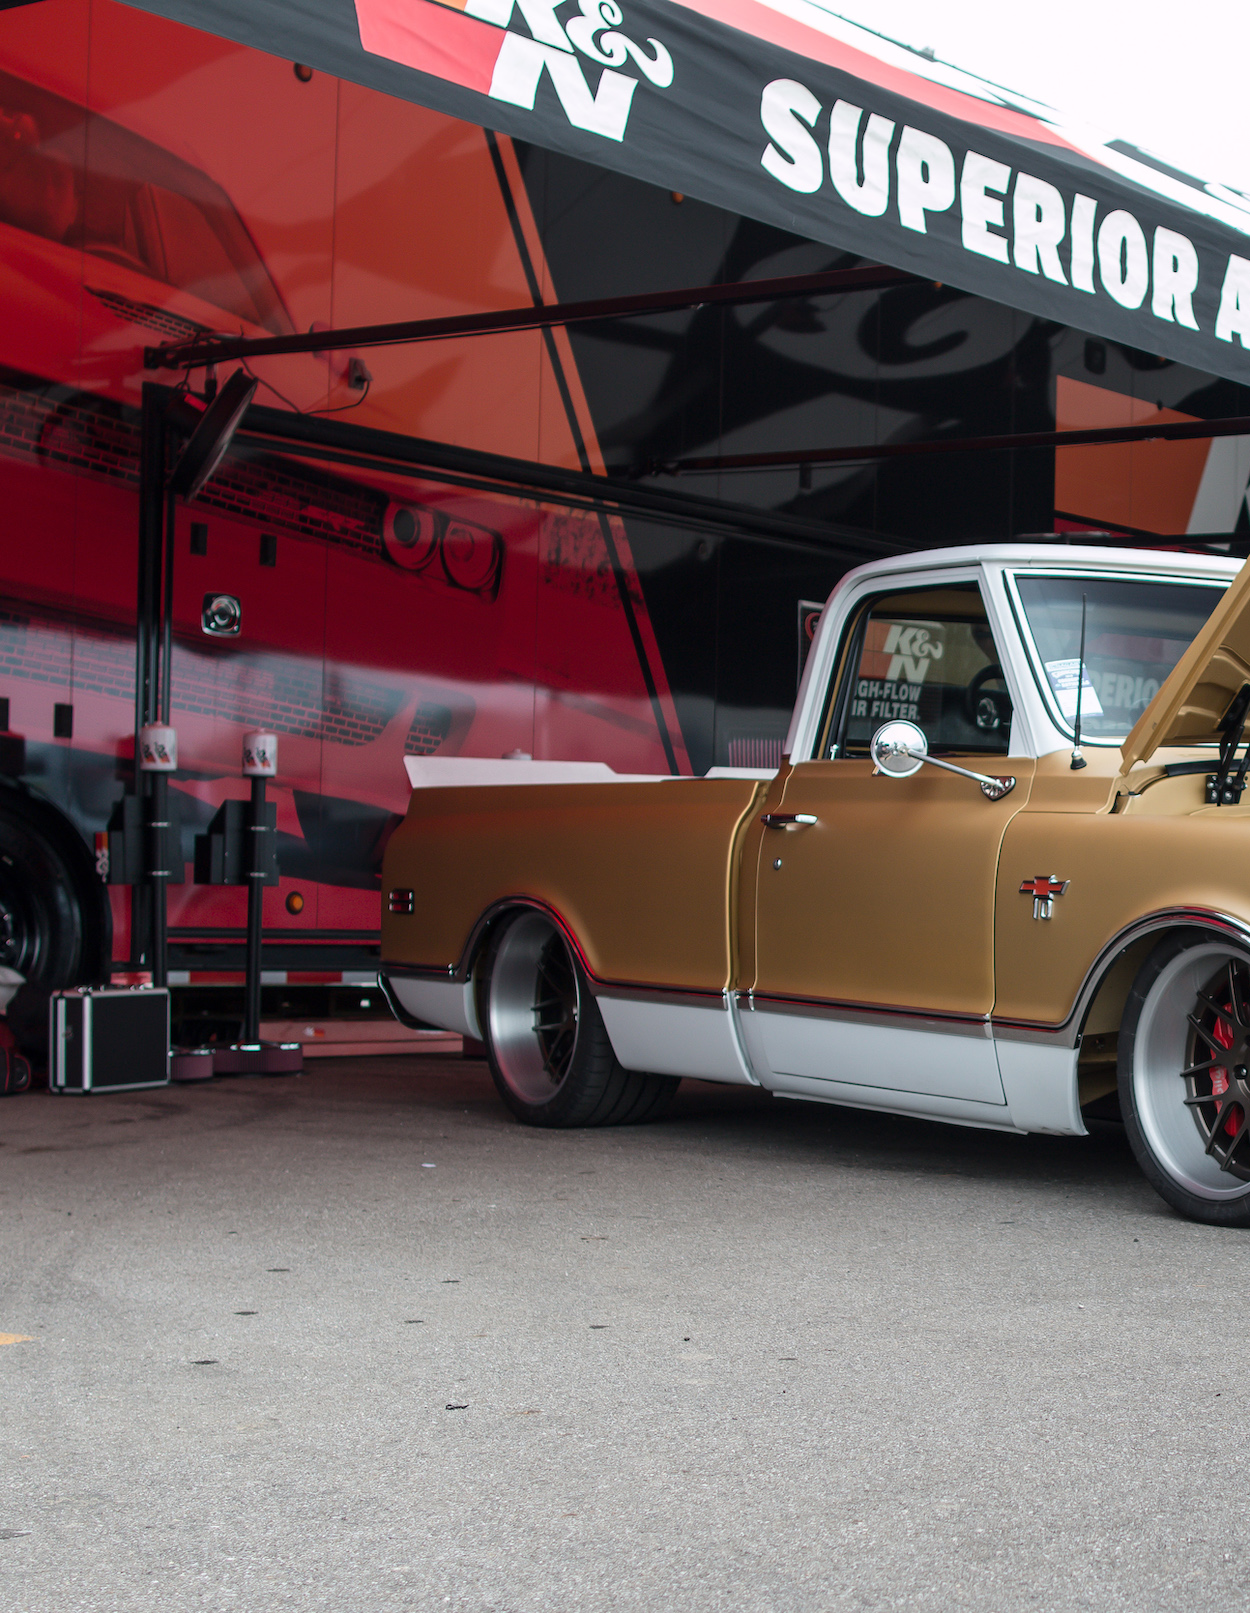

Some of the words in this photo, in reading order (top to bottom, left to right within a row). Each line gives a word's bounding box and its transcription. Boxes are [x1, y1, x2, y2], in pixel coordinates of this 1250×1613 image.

[488, 30, 639, 143] N
[760, 78, 1200, 331] SUPERIOR
[883, 624, 943, 660] K&
[885, 654, 931, 684] N
[870, 700, 921, 720] FILTER.
